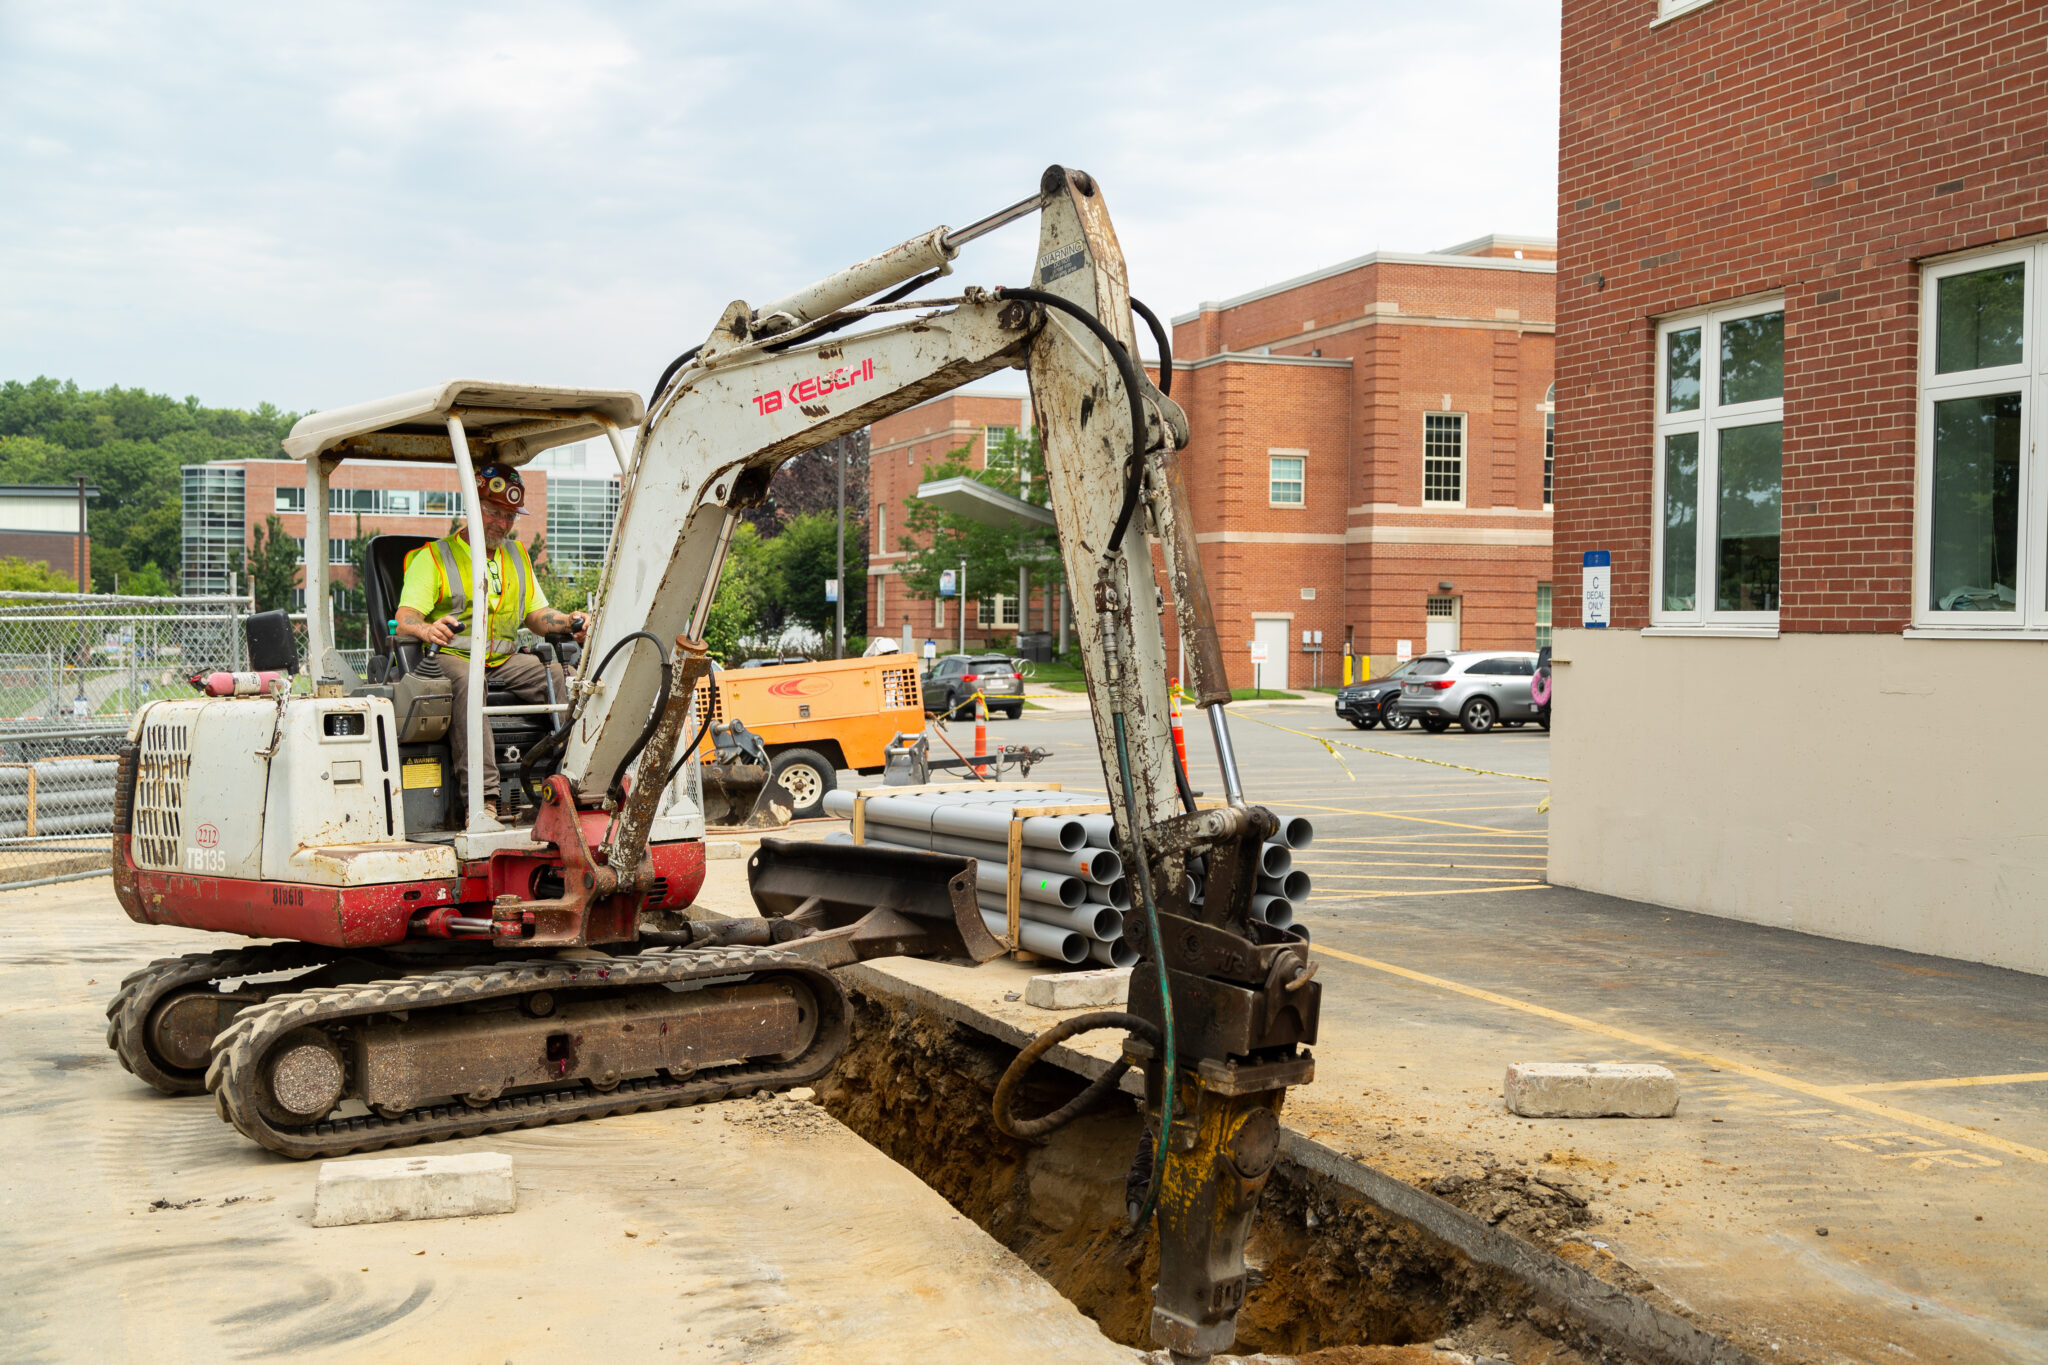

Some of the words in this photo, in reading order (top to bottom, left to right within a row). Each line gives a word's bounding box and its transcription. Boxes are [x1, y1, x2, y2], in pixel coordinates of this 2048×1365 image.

[1041, 240, 1082, 266] WARNING
[1592, 576, 1599, 589] C
[1586, 591, 1605, 600] DECAL
[1587, 601, 1604, 610] ONLY
[198, 828, 217, 844] 2212
[186, 847, 226, 872] TB135
